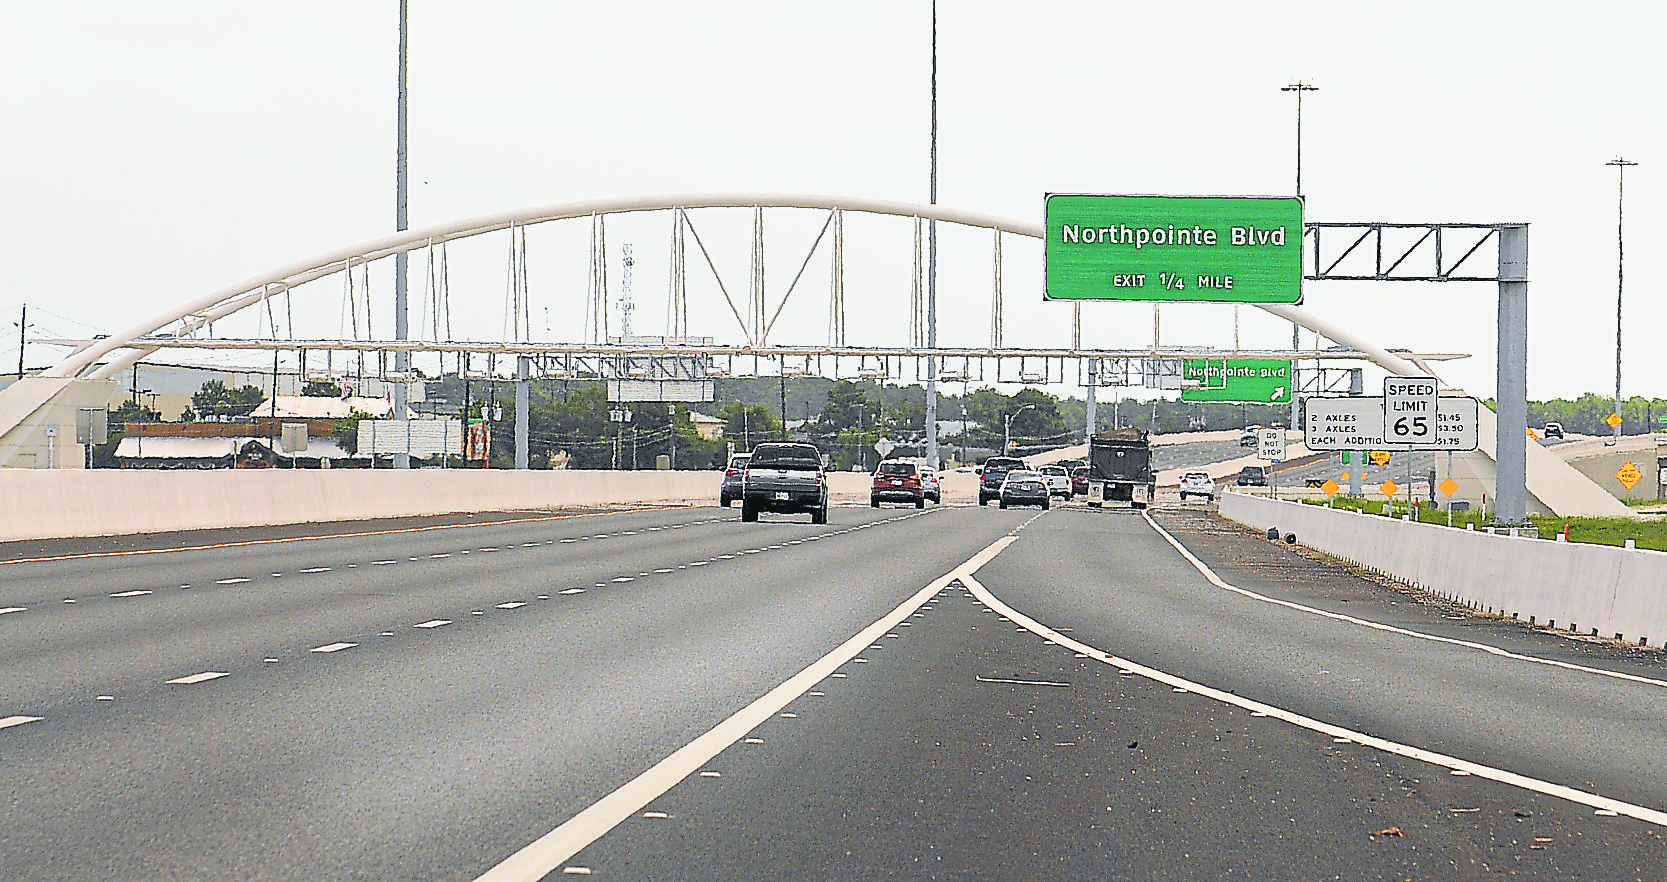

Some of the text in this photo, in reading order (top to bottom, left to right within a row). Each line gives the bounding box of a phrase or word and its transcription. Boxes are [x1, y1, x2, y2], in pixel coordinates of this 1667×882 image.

[1062, 223, 1287, 249] Northpointe Blvd
[1113, 272, 1233, 290] EXIT 1/4 MILE
[1260, 367, 1285, 378] Blvd
[1389, 385, 1433, 395] SPEED
[1393, 401, 1428, 411] LIMIT
[1393, 417, 1428, 436] 65
[1344, 437, 1384, 445] ADDITIO
